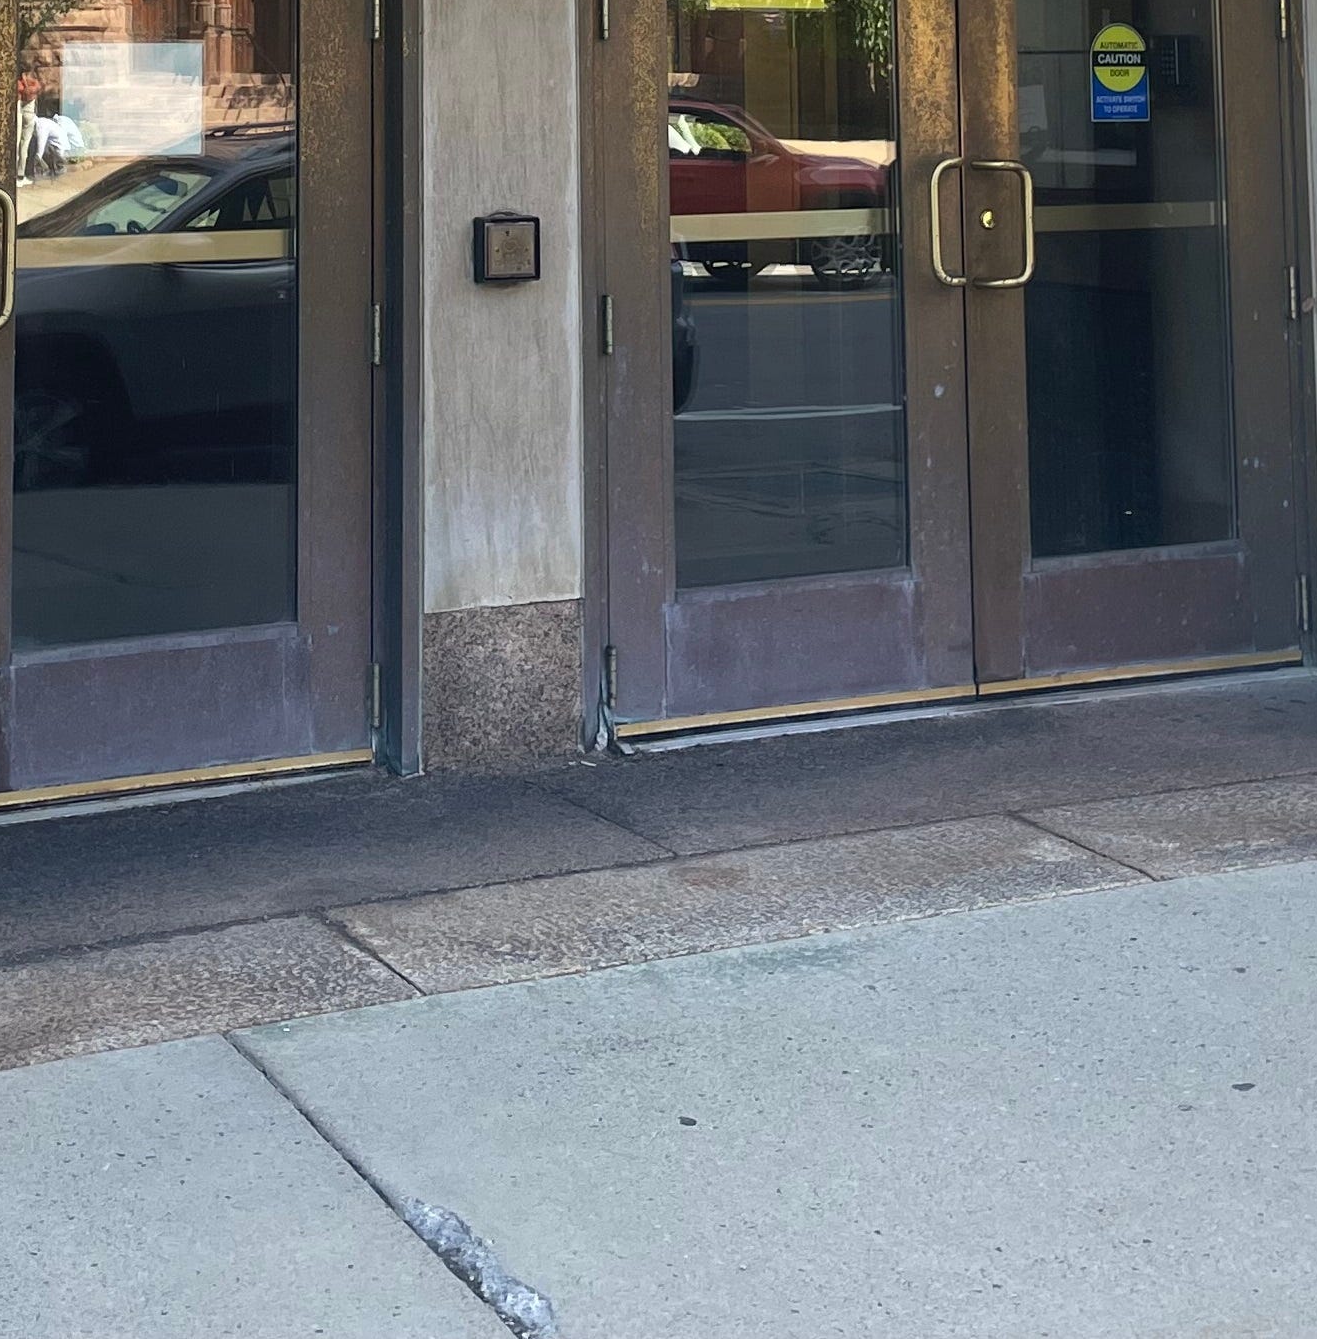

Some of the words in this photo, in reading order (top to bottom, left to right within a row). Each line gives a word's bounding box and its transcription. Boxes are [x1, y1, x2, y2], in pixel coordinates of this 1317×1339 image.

[1099, 41, 1139, 50] AUTOMATIC
[1097, 53, 1142, 65] CAUTION
[1109, 68, 1130, 77] DOOR
[1103, 104, 1112, 114] TO
